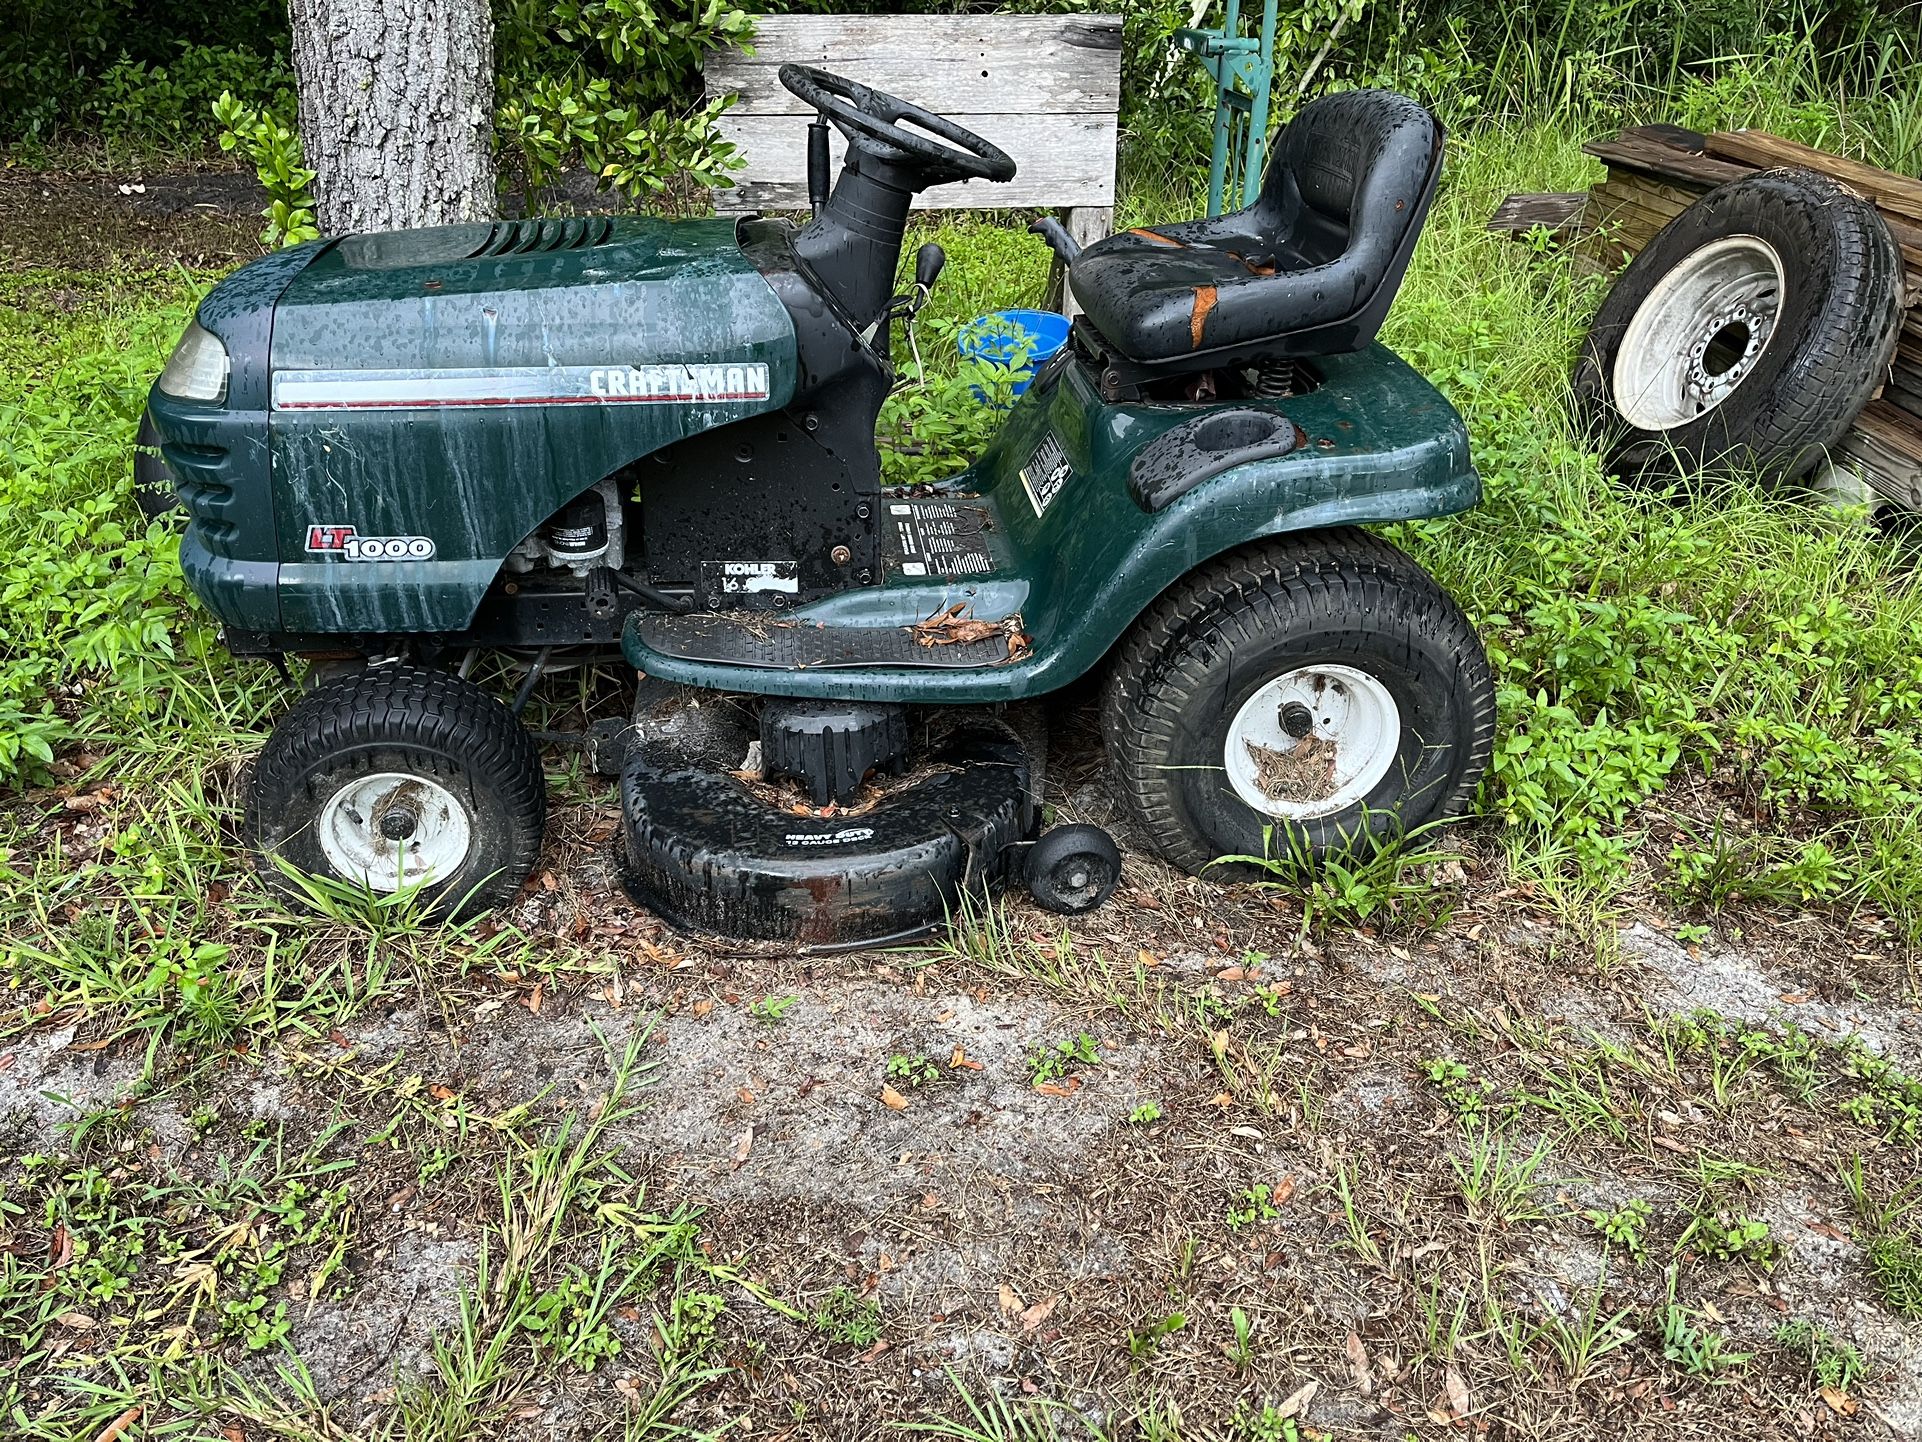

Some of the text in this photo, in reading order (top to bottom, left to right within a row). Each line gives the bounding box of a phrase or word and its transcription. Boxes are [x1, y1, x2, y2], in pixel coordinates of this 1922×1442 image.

[310, 527, 432, 557] LT 1000
[724, 563, 777, 575] KOHLER
[835, 829, 874, 839] DUTY
[842, 835, 873, 843] DECK
